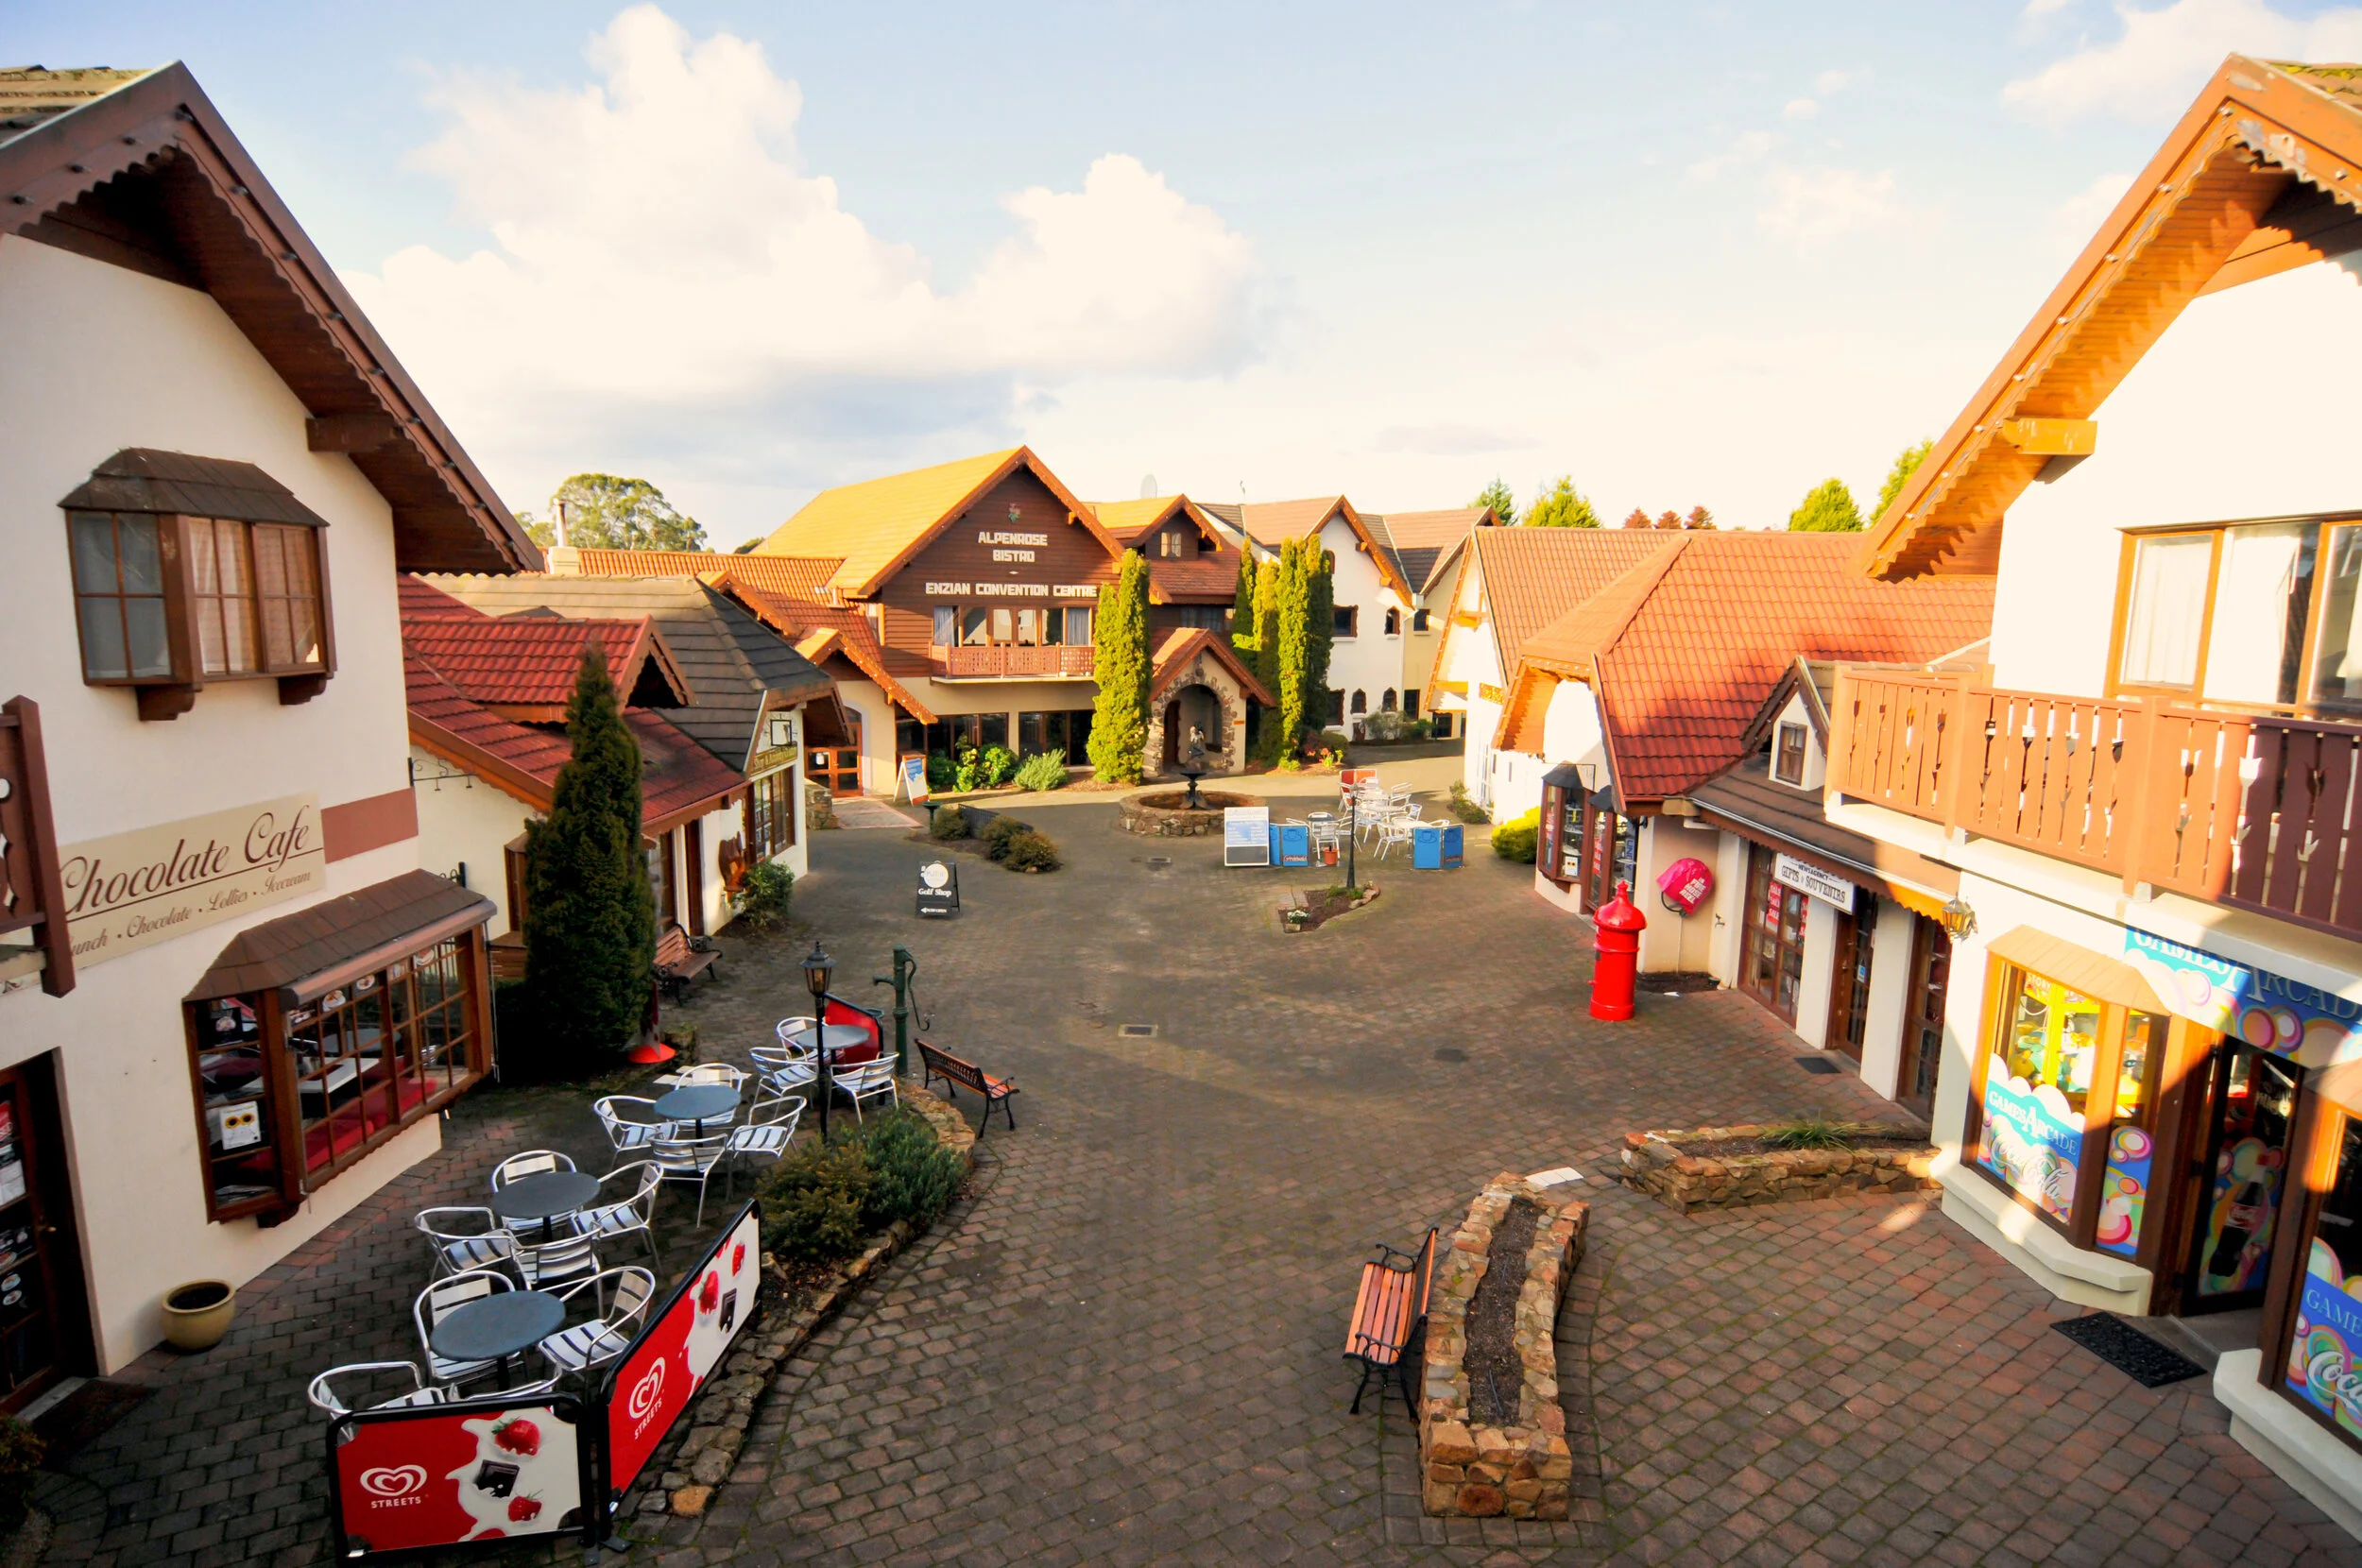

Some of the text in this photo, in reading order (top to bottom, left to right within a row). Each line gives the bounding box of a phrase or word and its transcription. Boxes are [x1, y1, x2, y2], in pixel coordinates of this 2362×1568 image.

[978, 531, 1048, 547] ALPENROSE
[993, 550, 1036, 563] BISTRO
[925, 582, 1098, 598] ENZIAN CONVENTION CENTRE
[60, 804, 310, 915] Chocolate Cafe
[1798, 863, 1829, 881] NEWSAGENCY
[934, 889, 951, 897] Shop
[1781, 865, 1800, 883] GIFTS
[1806, 875, 1846, 904] SOUVENIRS
[69, 929, 109, 955] unch
[127, 914, 193, 938] Chocolate
[2219, 963, 2362, 1025] ARCAD
[2022, 1105, 2079, 1156] ARCADE
[635, 1397, 662, 1440] STREETS
[370, 1496, 421, 1509] STREETS
